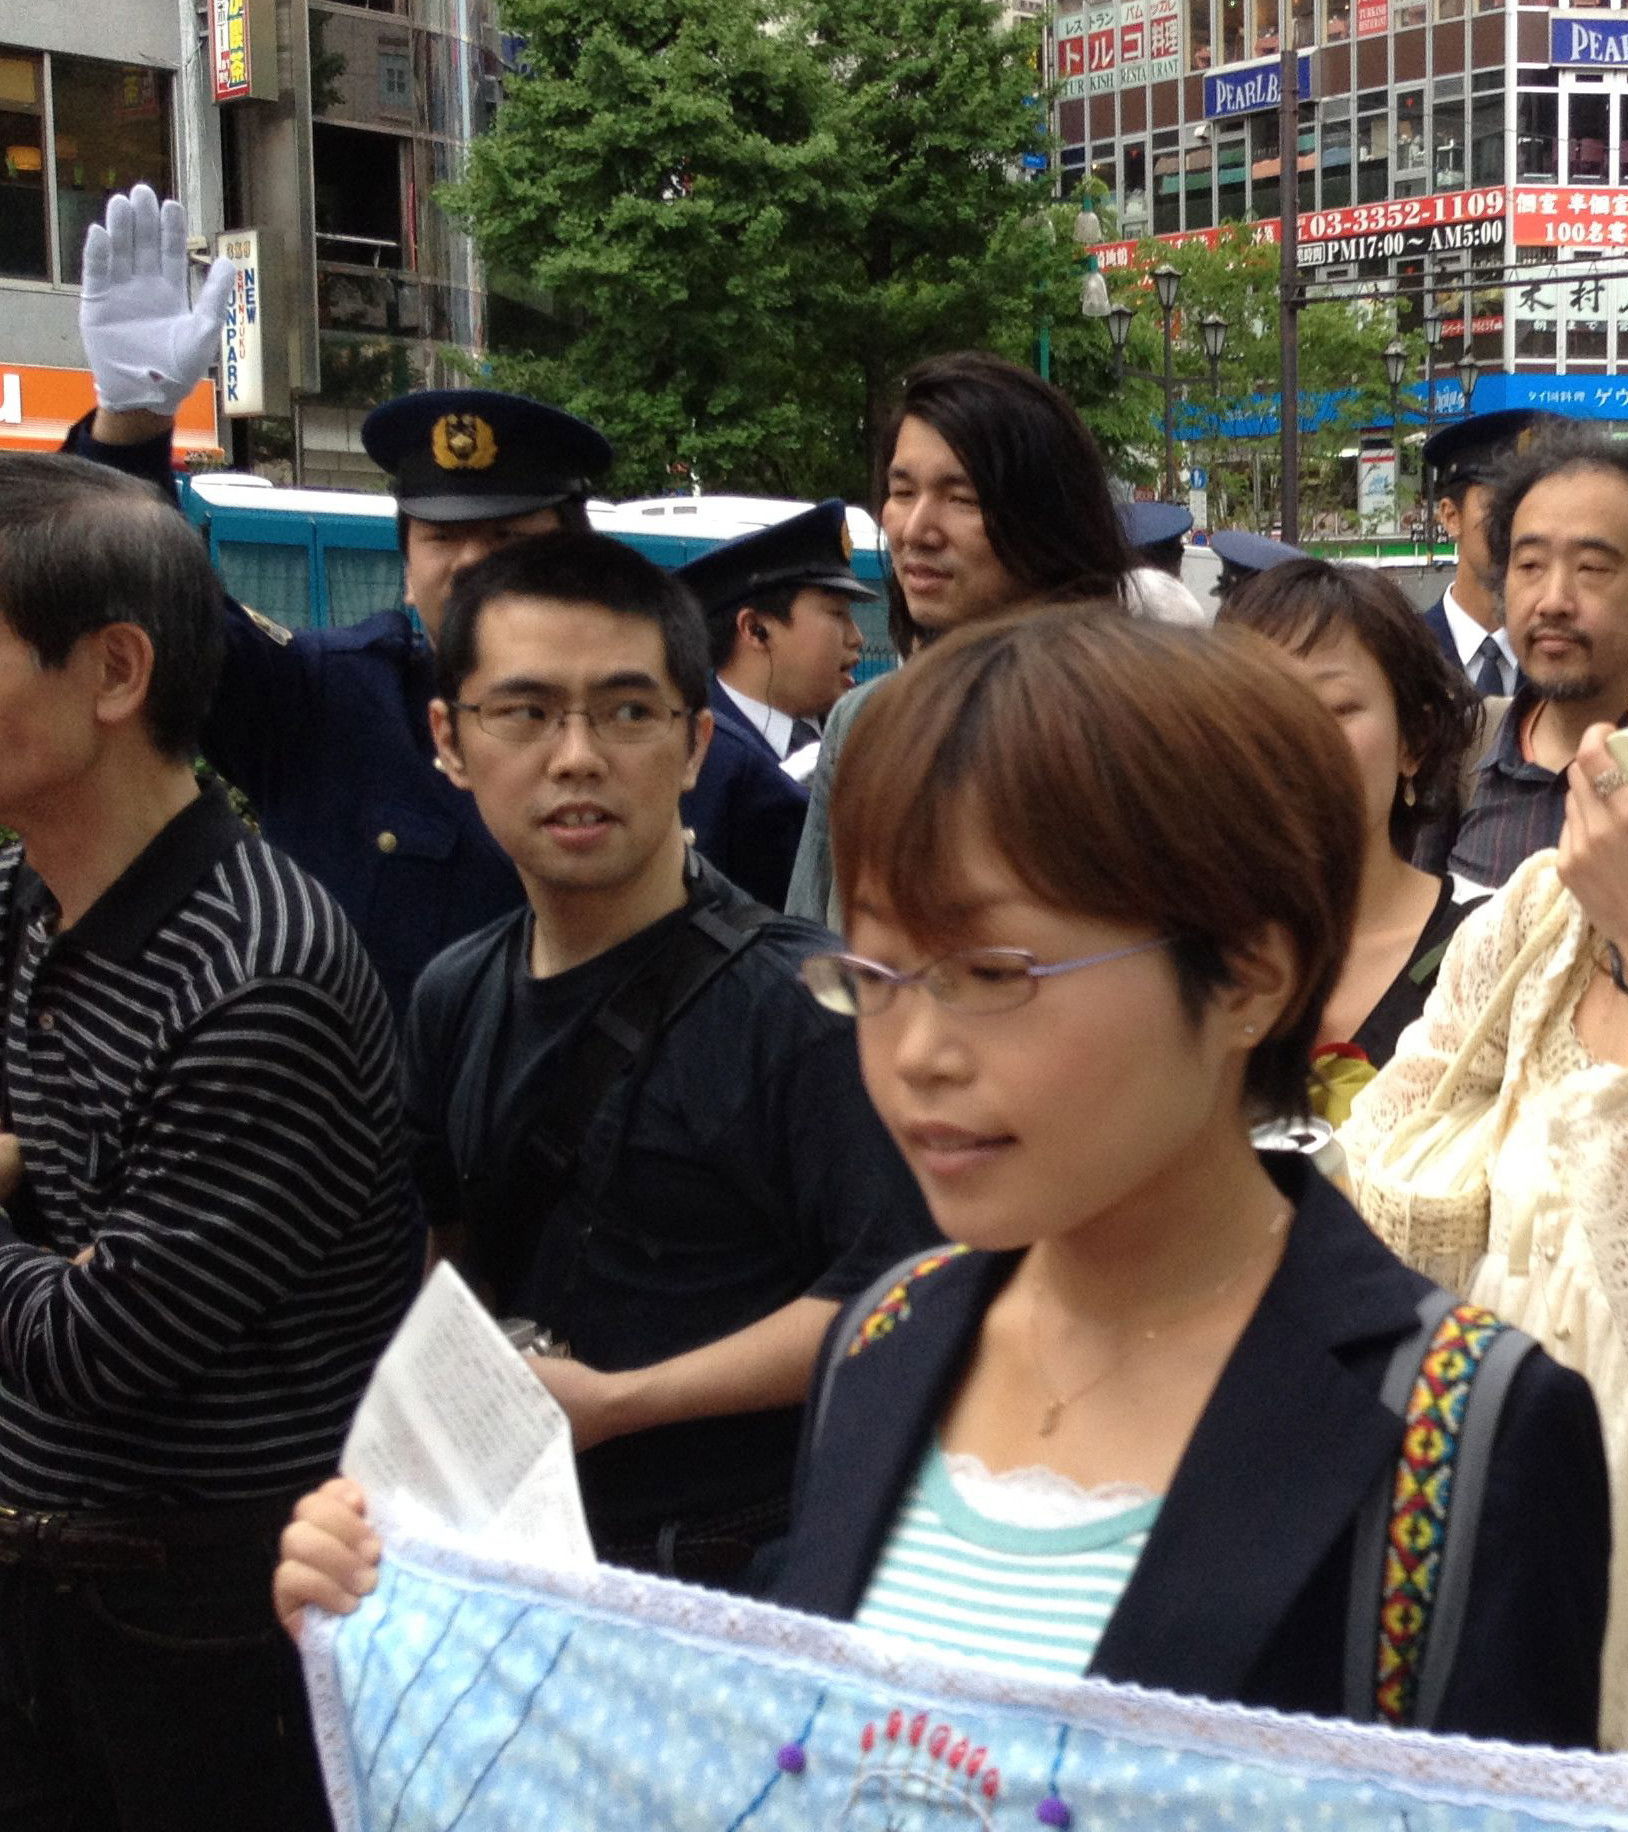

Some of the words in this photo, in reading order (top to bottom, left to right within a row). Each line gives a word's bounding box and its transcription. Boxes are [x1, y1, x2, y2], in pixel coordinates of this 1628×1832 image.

[1064, 18, 1179, 77] トルコ料理
[1215, 73, 1268, 114] PEARL
[1309, 189, 1504, 239] 03-3352-1109
[1516, 192, 1559, 215] 個室
[1326, 233, 1405, 264] PM17:00
[1428, 219, 1503, 251] AM5:00
[237, 271, 246, 360] SHINJUKU
[245, 267, 257, 325] NEW
